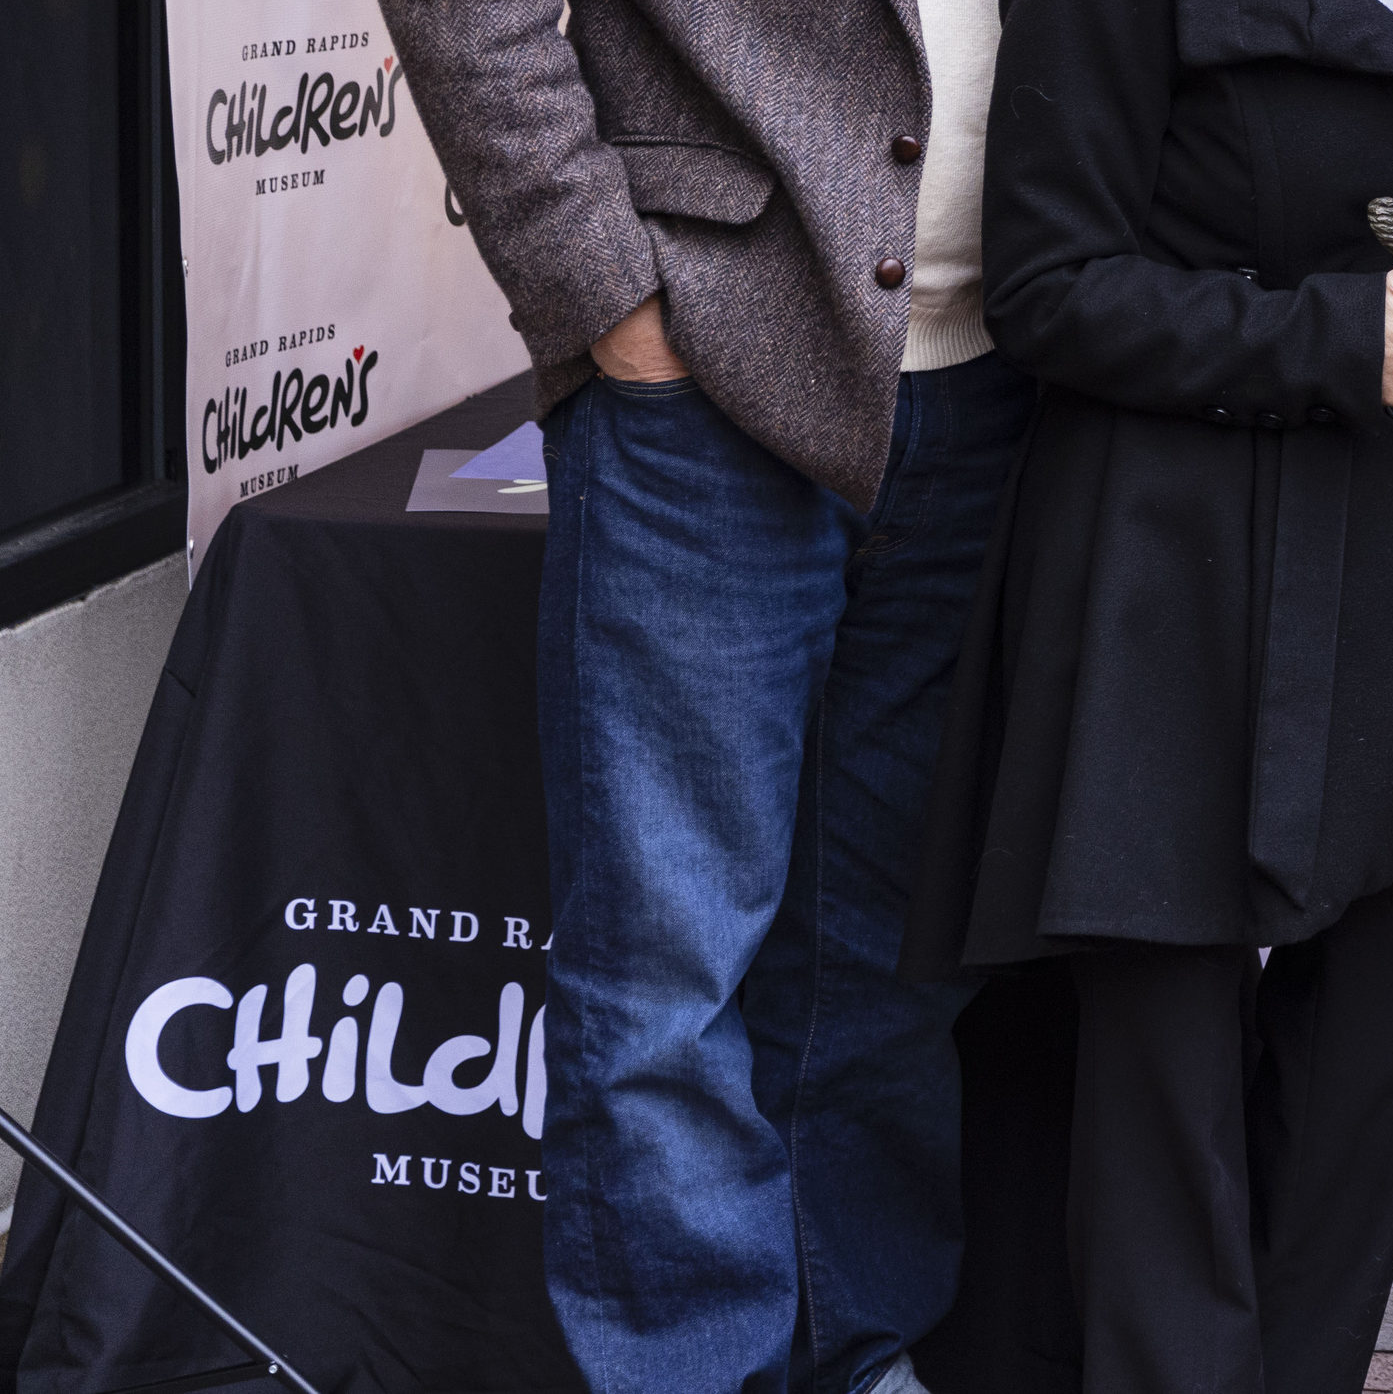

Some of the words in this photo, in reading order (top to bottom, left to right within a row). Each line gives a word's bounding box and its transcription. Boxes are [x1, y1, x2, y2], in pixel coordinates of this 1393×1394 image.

[241, 39, 296, 62] GRAND
[306, 31, 370, 54] RAPIDS
[255, 169, 326, 196] MUSEUM
[225, 339, 269, 368] GRAND
[278, 324, 336, 352] RAPIDS
[240, 464, 300, 498] MUSEUM
[285, 897, 480, 943] GRAND
[371, 1153, 548, 1201] MUSEU
